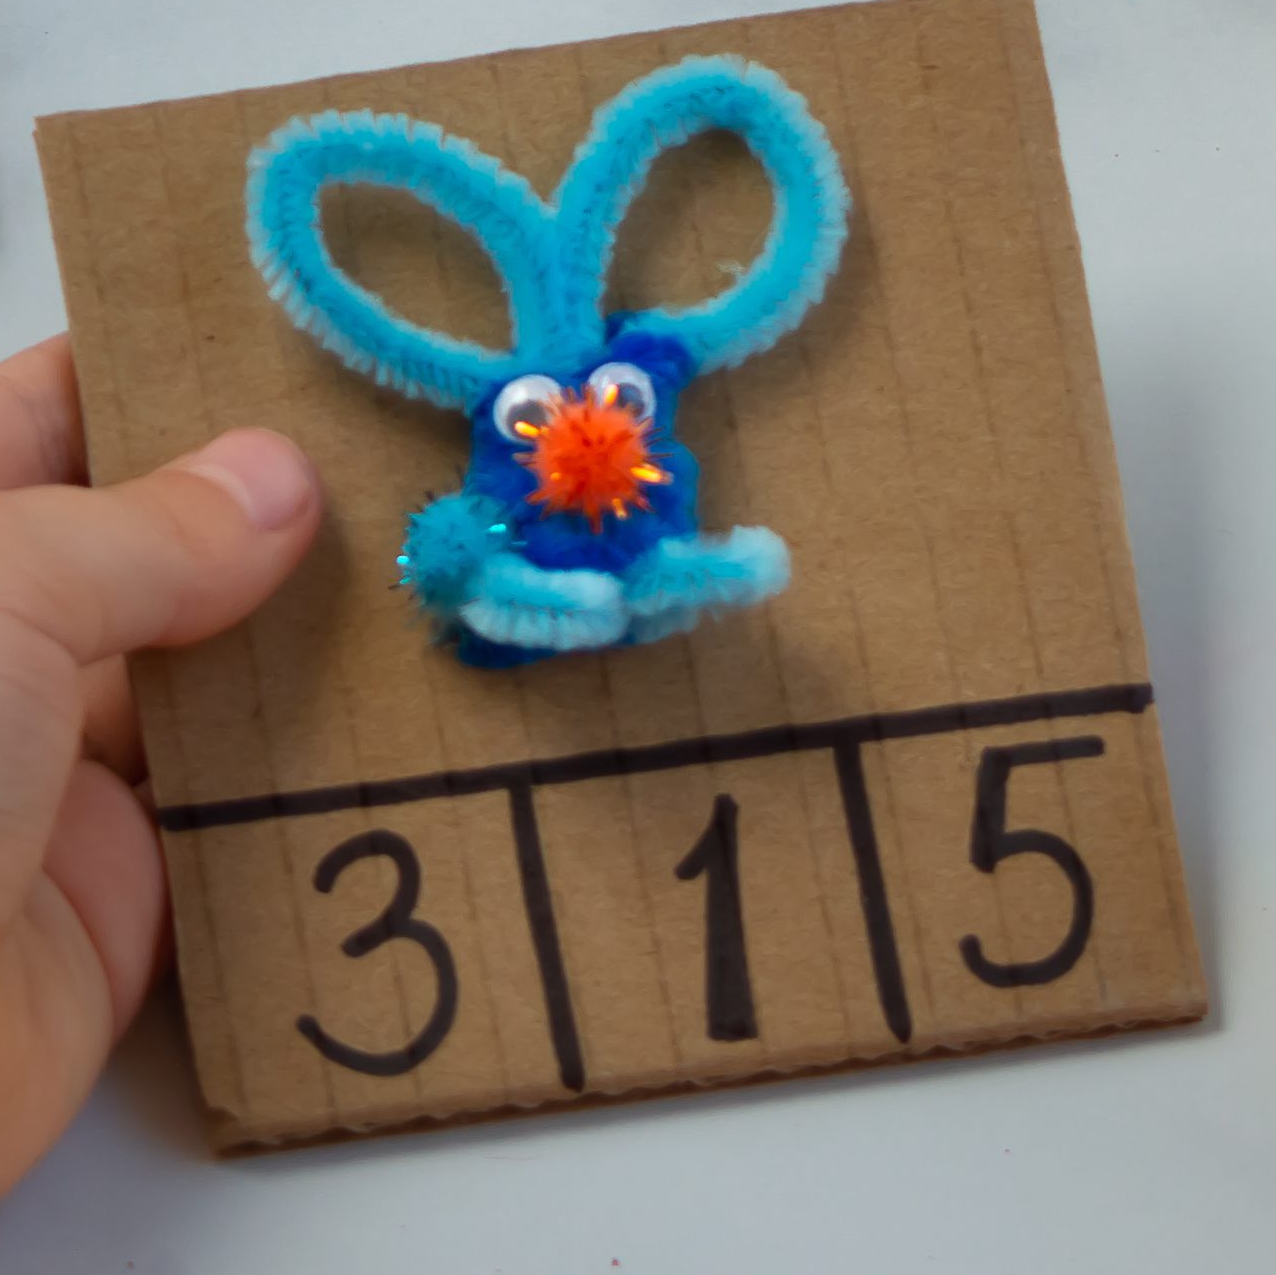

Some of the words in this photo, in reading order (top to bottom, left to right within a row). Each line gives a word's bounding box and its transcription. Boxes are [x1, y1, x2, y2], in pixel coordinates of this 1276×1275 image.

[296, 829, 457, 1078] 3
[674, 794, 758, 1042] 1
[960, 735, 1104, 990] 5
